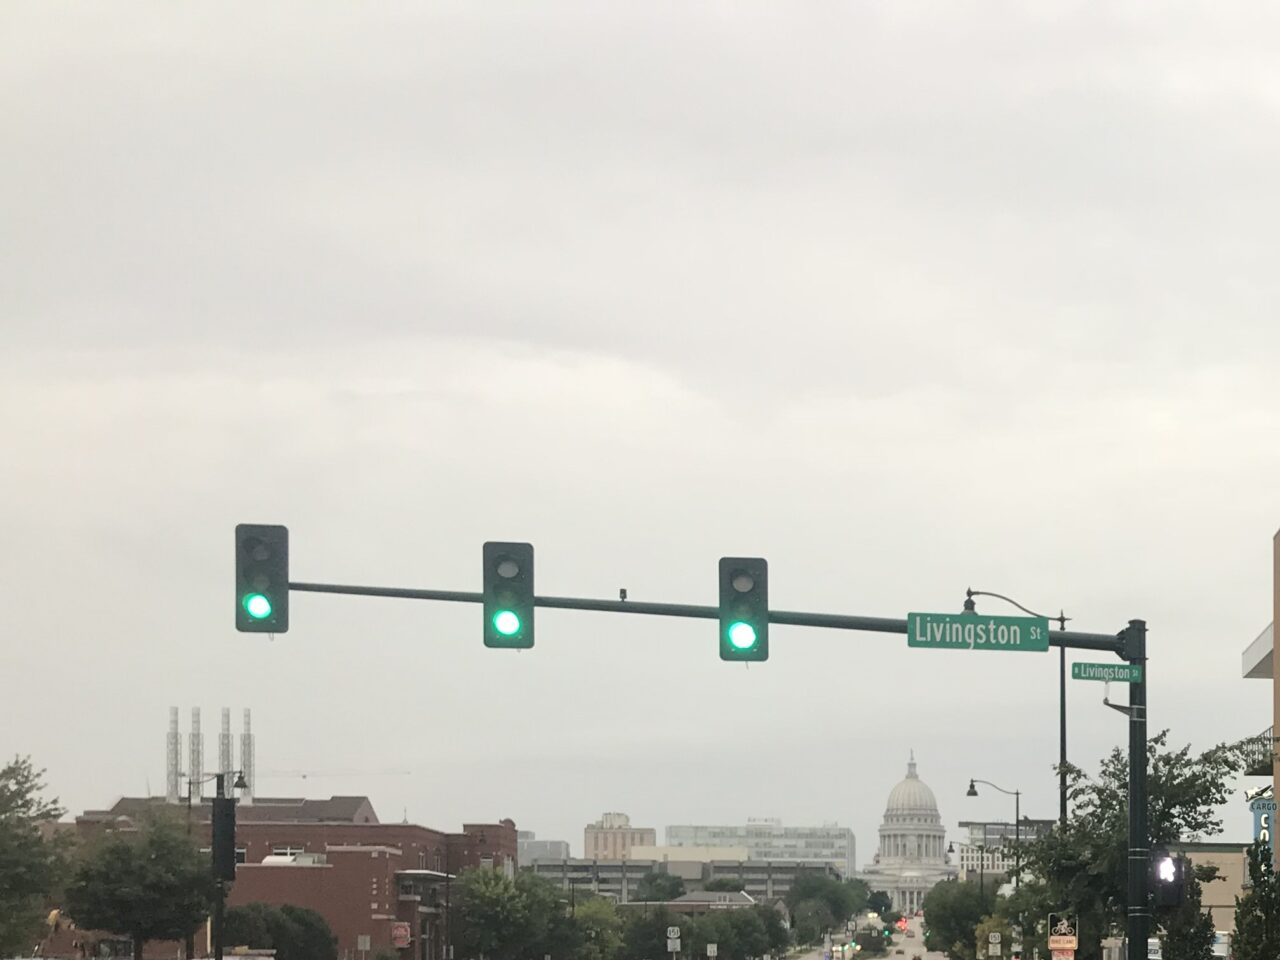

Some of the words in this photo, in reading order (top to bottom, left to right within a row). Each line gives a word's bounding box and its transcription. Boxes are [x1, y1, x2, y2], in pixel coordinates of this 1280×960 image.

[915, 616, 1021, 650] Livingston
[1030, 626, 1041, 640] St
[1081, 663, 1130, 681] Livingston
[1250, 801, 1278, 812] CARGO
